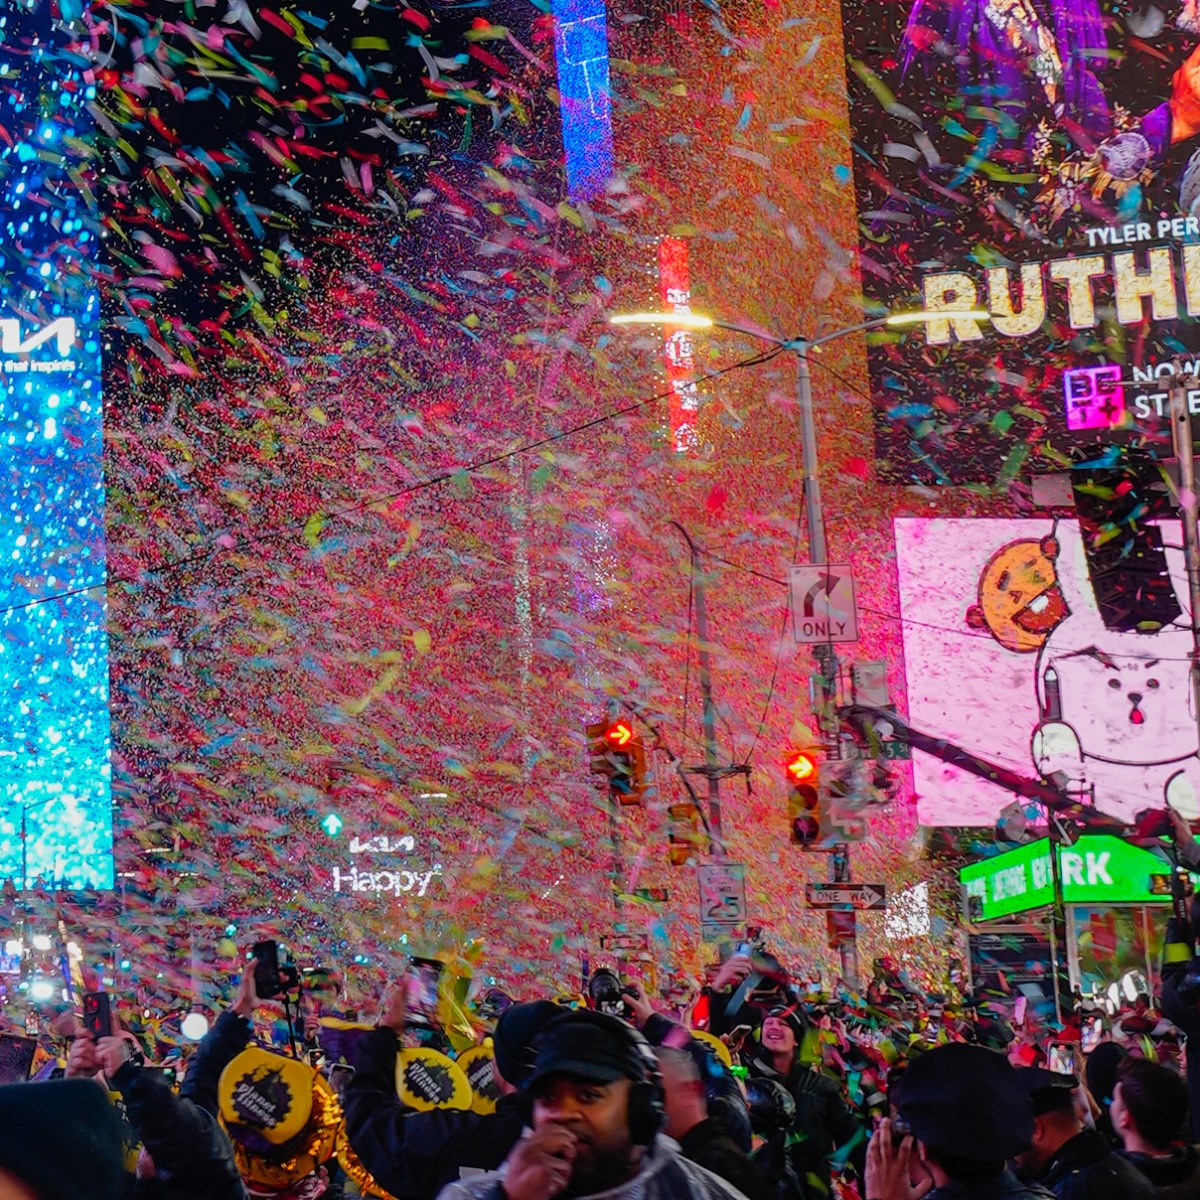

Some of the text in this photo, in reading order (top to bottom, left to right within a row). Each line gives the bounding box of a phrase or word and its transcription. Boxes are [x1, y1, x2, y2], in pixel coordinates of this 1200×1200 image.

[1085, 215, 1200, 248] TYLER PER
[4, 360, 29, 373] that
[1134, 390, 1200, 419] STE
[802, 621, 847, 638] ONLY
[332, 866, 433, 897] Happy
[816, 891, 875, 902] ONE WAY
[236, 1083, 276, 1113] planet
